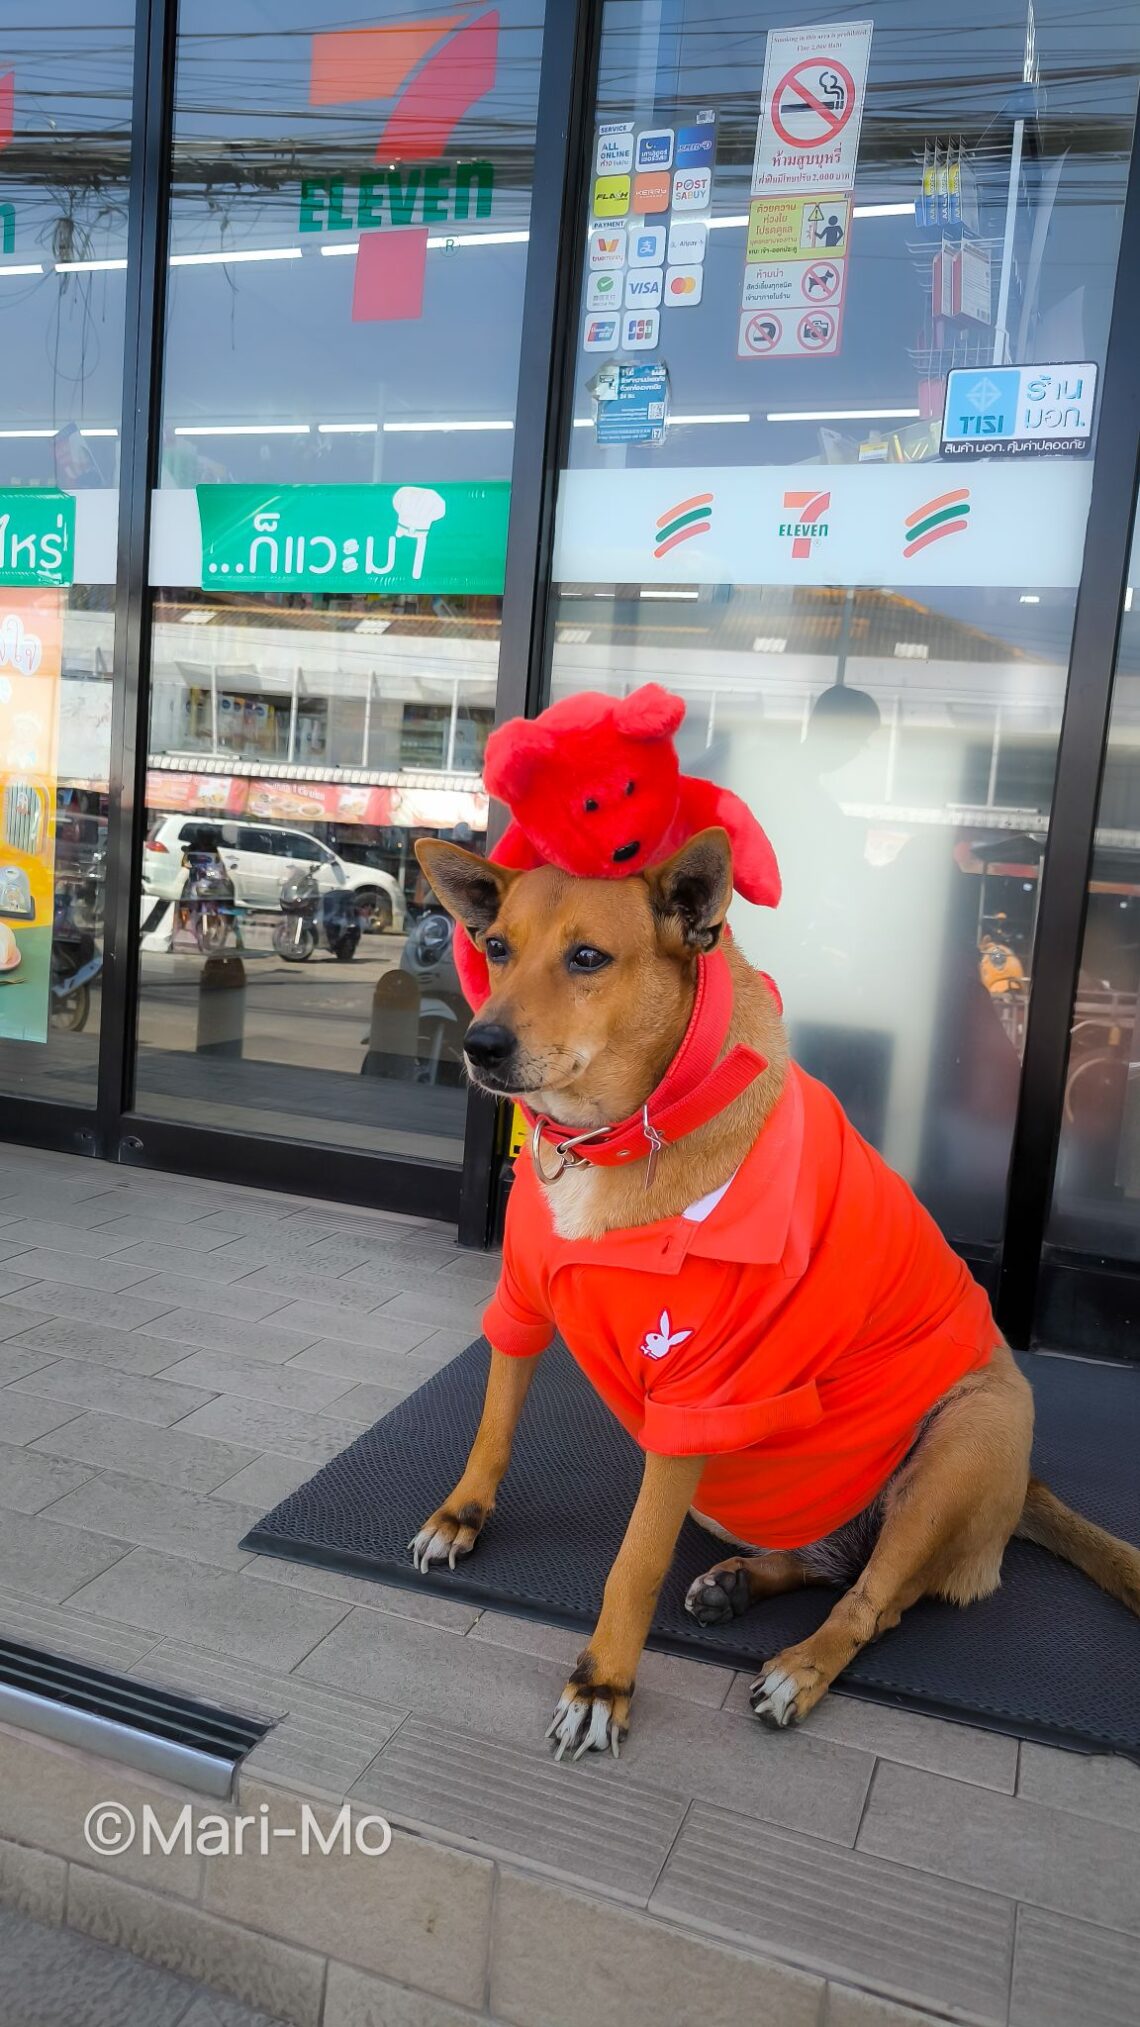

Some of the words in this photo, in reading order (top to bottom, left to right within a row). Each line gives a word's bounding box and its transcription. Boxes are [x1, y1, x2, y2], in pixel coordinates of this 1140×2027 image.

[600, 125, 627, 133] SERVICE
[602, 141, 619, 151] ALL
[600, 150, 630, 159] ONLINE
[772, 142, 842, 170] ห้ามสูบบุหรี่
[813, 173, 834, 182] 2,000
[676, 179, 708, 191] POST
[675, 189, 707, 200] SABUY
[593, 220, 624, 228] PAYMENT
[629, 281, 659, 294] VISA
[1026, 374, 1084, 401] ร้าน
[1025, 406, 1086, 429] มอก.
[959, 415, 1004, 434] TISI
[944, 442, 977, 454] สินค้า
[977, 445, 1005, 453] มอก.
[1007, 439, 1086, 454] คุ้มค่าปลอดภัย
